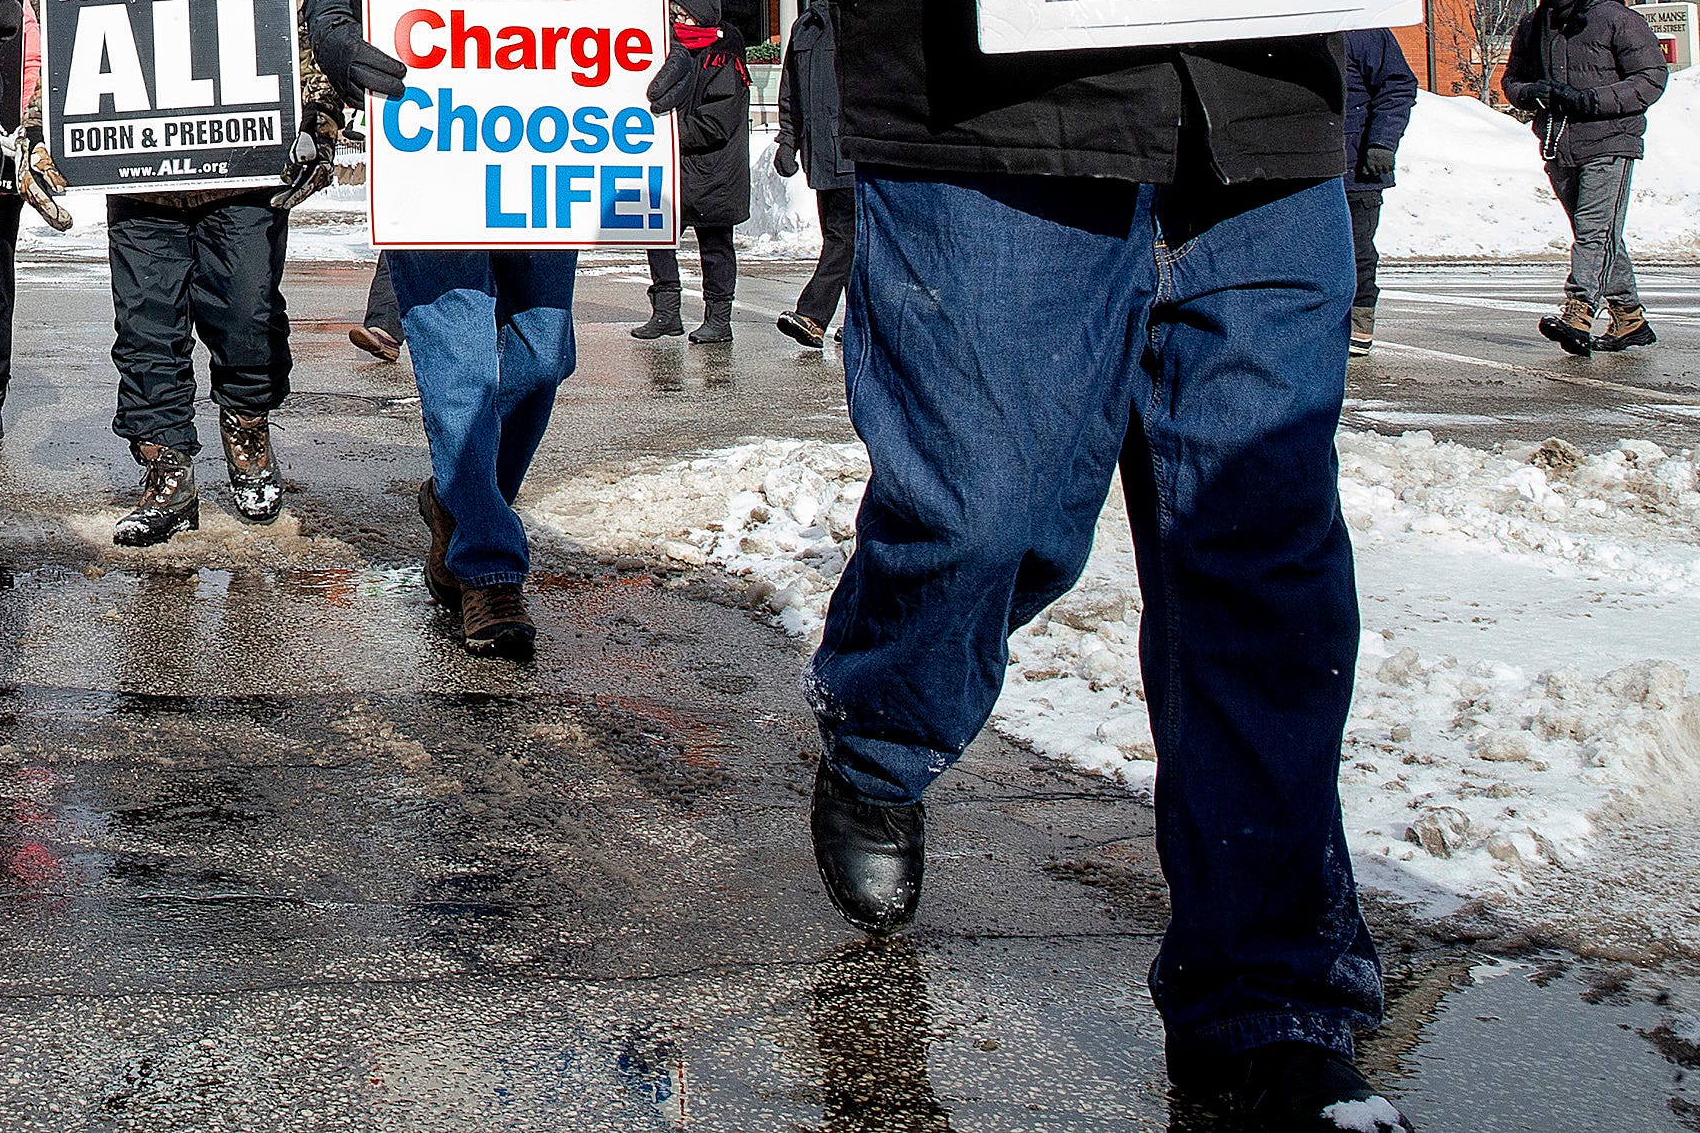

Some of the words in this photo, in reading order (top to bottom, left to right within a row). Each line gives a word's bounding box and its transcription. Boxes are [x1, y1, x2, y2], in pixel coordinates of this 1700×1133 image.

[1658, 11, 1687, 23] MANSE
[1663, 23, 1686, 33] STREET
[392, 7, 654, 88] Charge
[70, 124, 136, 154] BORN
[140, 127, 159, 149] &
[163, 115, 275, 148] PREBORN
[381, 85, 656, 155] Choose
[117, 157, 230, 179] www.ALL.org
[484, 163, 664, 230] LIFE!
